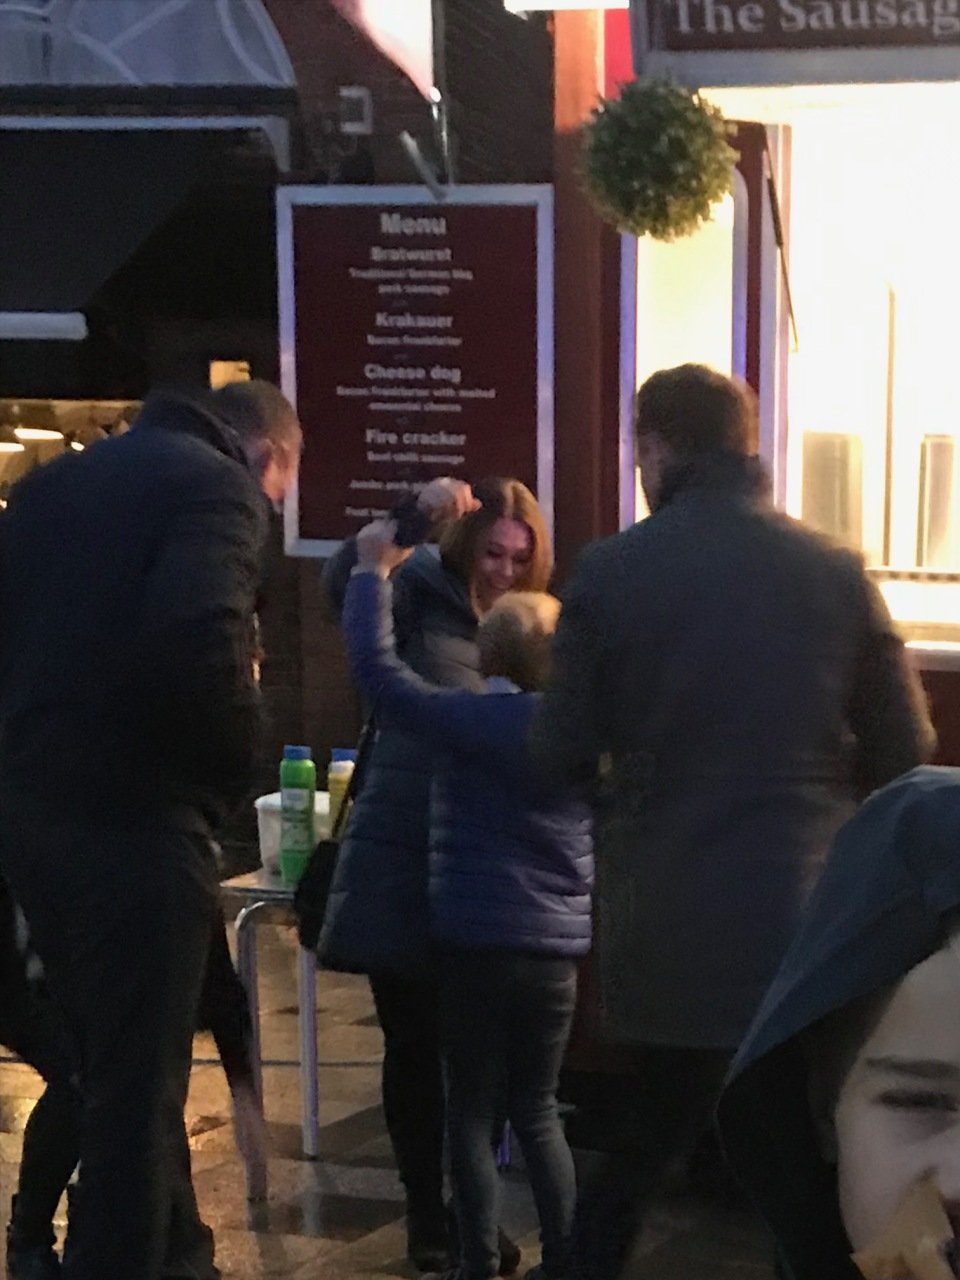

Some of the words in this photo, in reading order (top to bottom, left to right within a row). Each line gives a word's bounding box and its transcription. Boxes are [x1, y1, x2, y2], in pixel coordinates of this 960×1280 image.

[380, 213, 447, 236] Menu
[371, 246, 453, 261] Bratwurst
[376, 311, 454, 328] Krakauer
[363, 362, 426, 380] Cheese
[430, 363, 462, 384] dog
[364, 427, 398, 445] Fire
[402, 429, 467, 446] cracker
